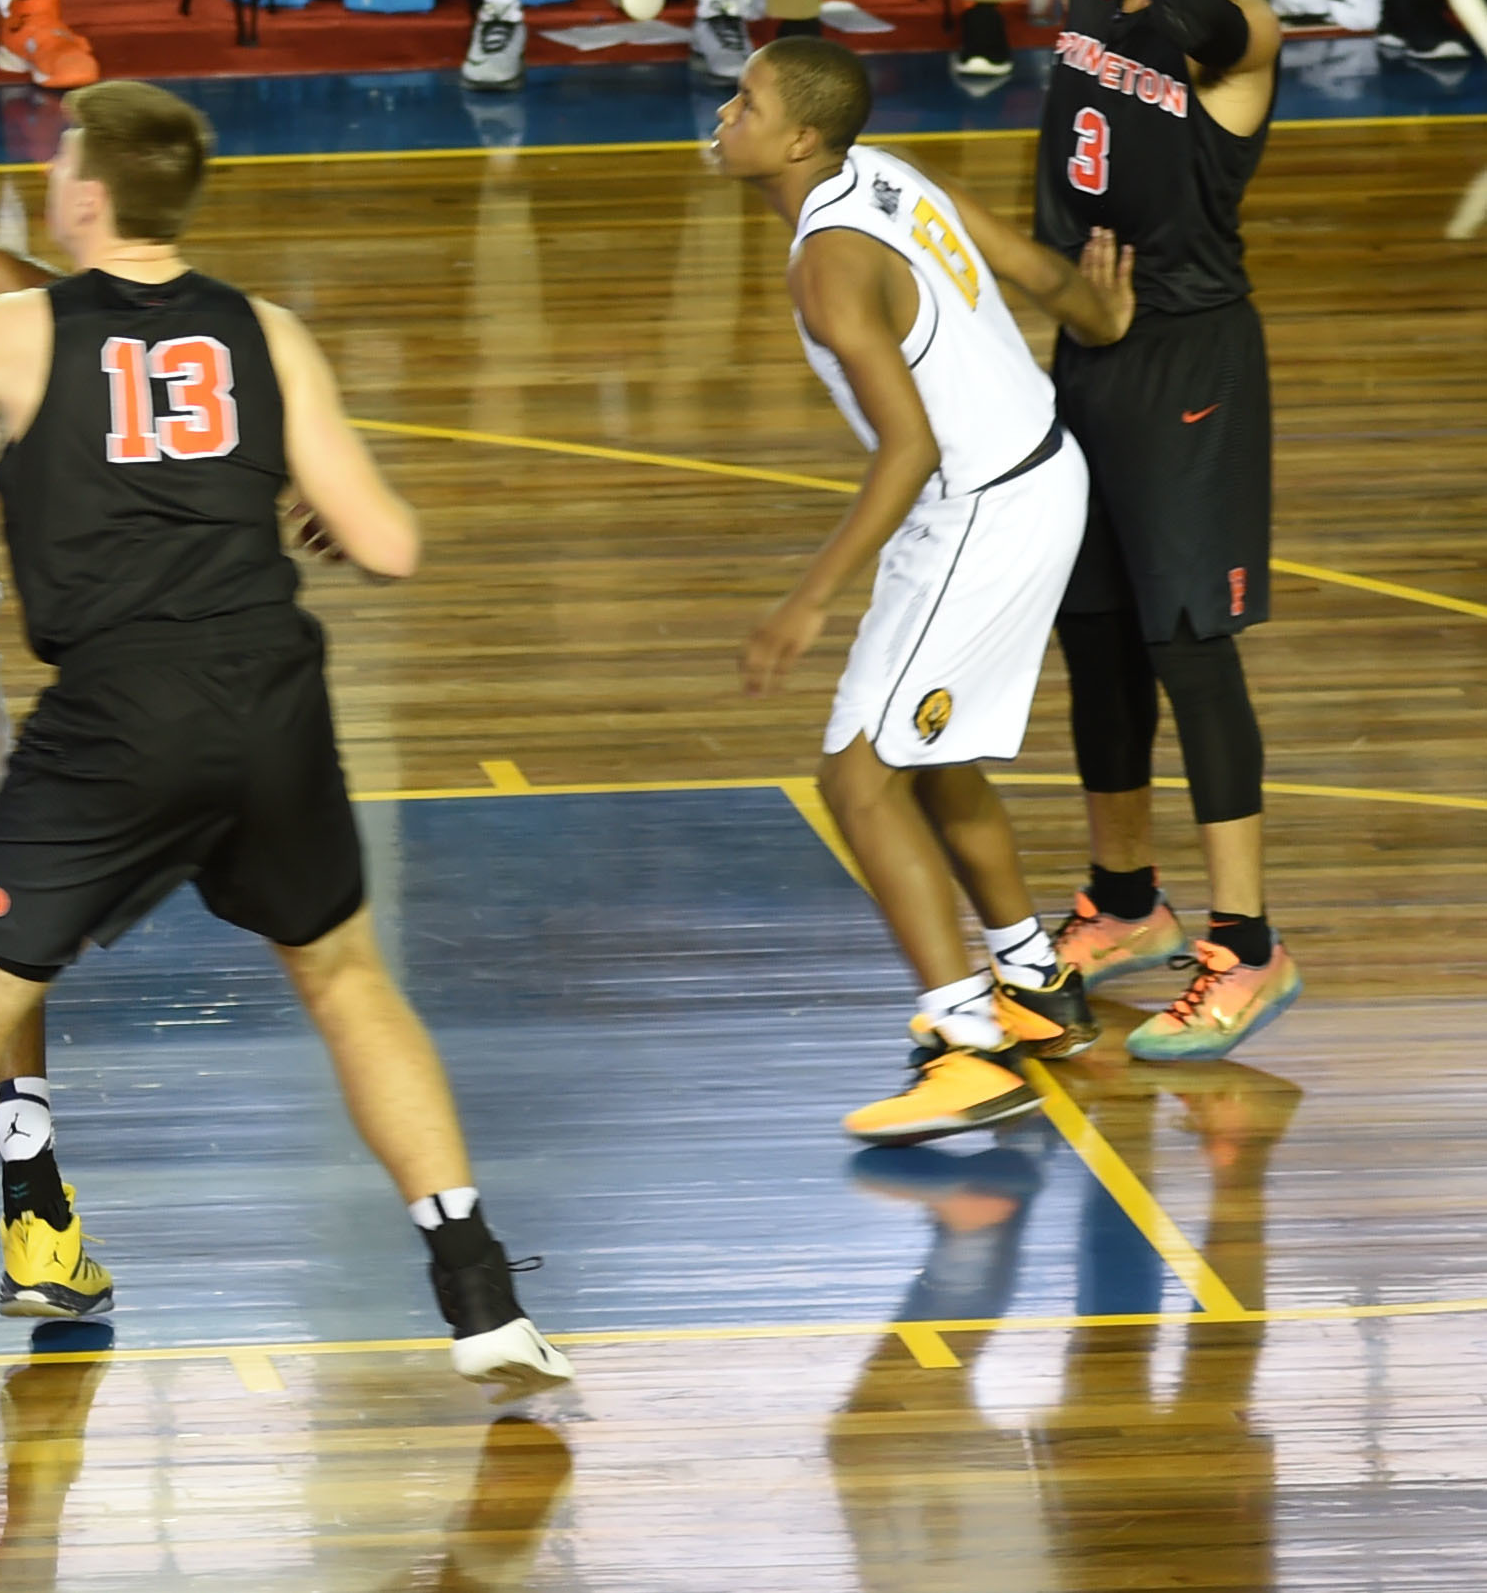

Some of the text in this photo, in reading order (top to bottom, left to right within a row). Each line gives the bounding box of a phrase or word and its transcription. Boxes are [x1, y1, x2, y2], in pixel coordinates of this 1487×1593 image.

[1054, 31, 1189, 119] RINETON
[1067, 106, 1110, 196] 3
[100, 335, 240, 464] 13
